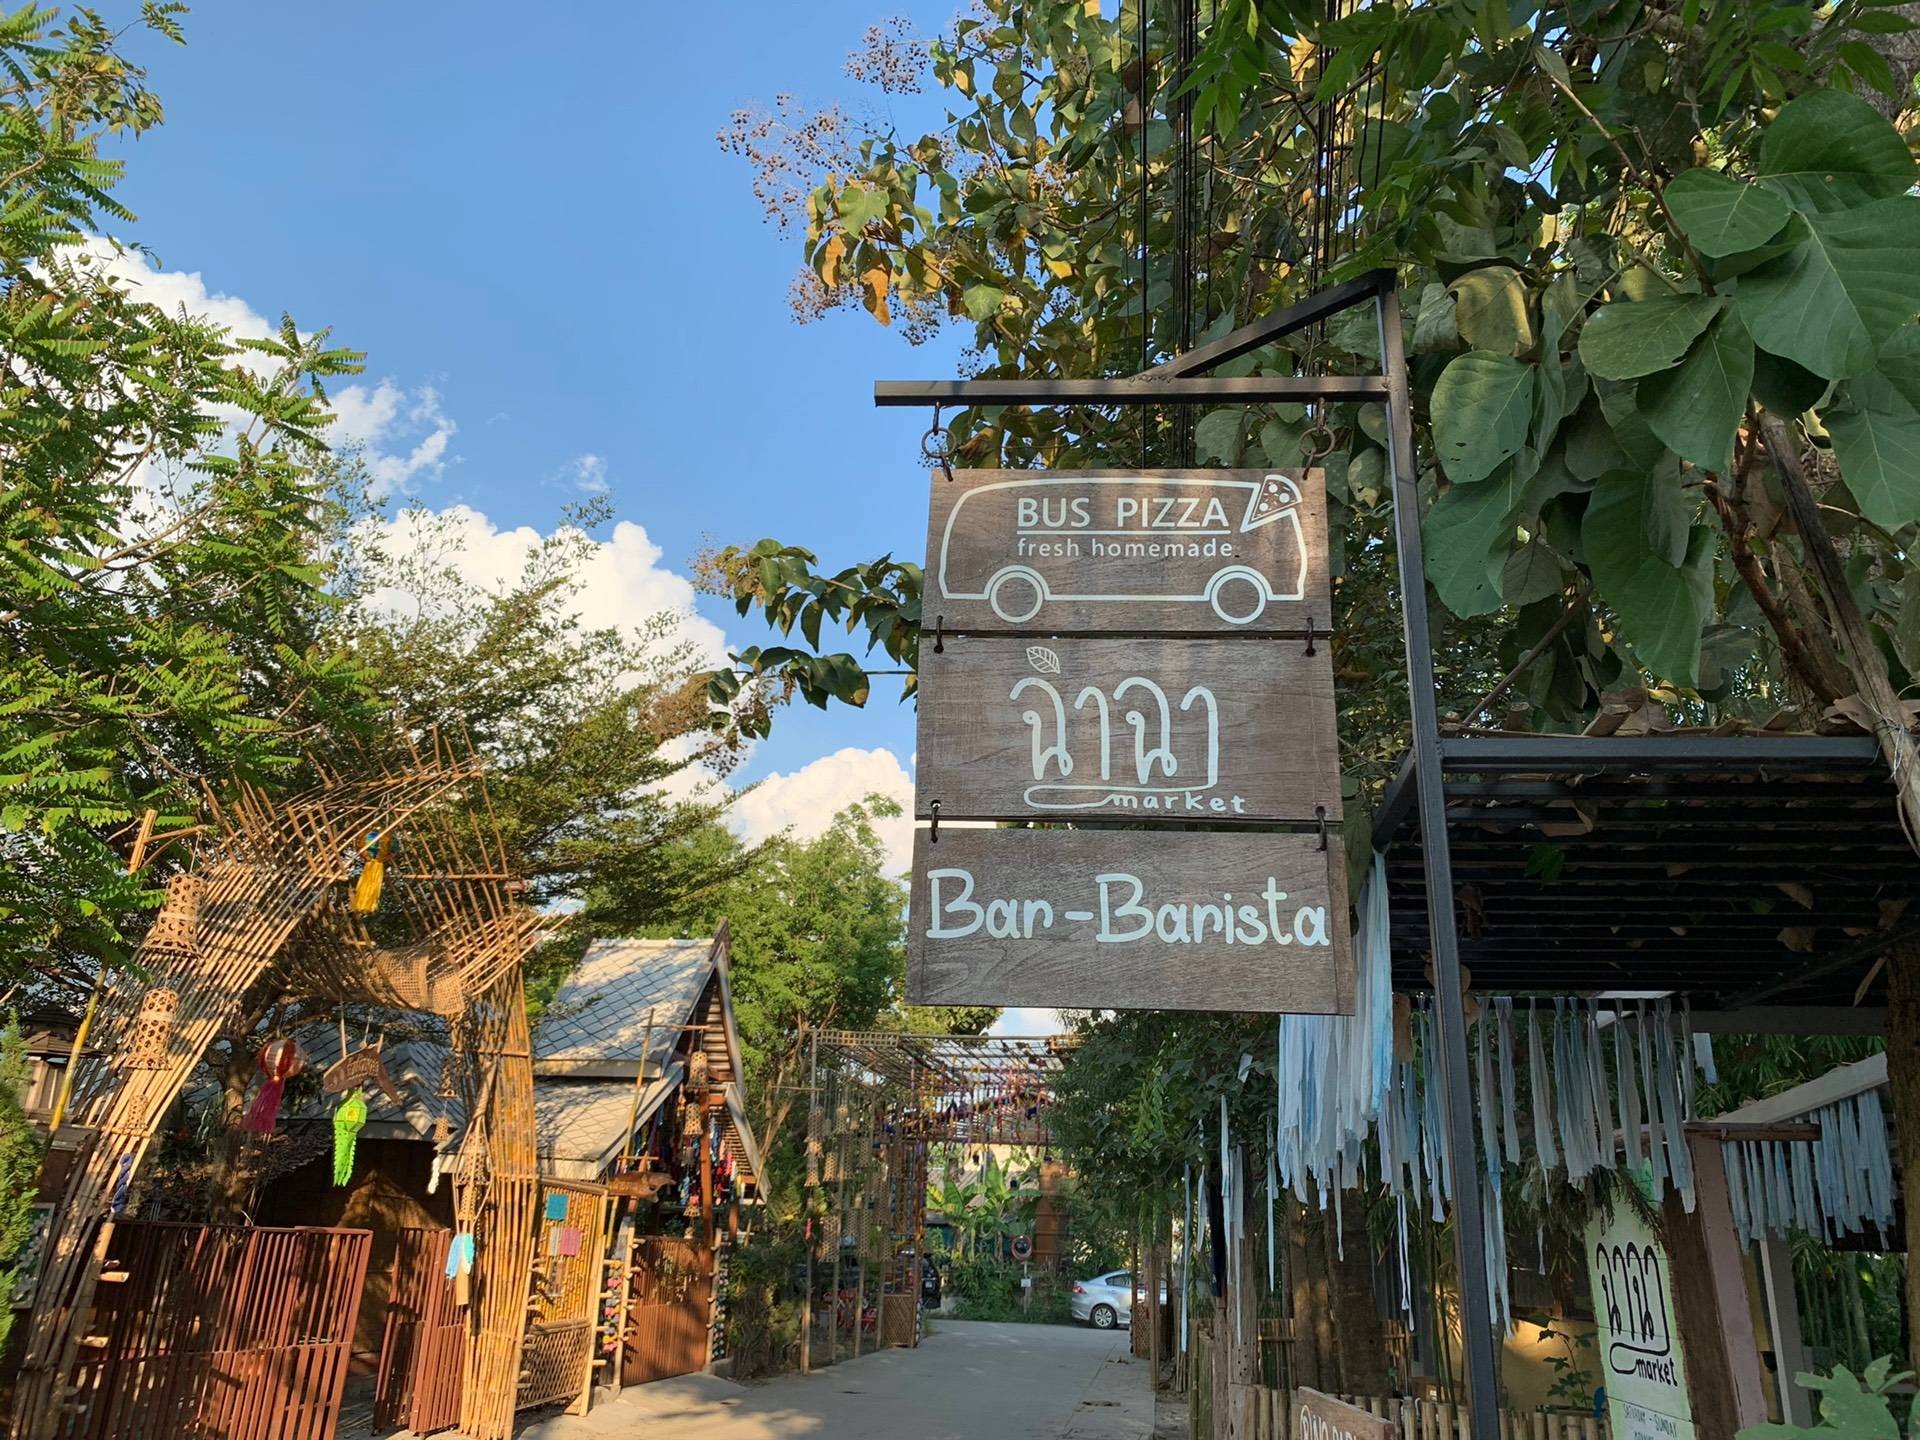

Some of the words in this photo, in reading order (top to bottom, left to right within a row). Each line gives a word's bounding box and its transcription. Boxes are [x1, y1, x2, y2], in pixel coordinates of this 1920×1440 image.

[1017, 497, 1091, 528] BUS
[1117, 498, 1231, 528] PIZZA
[1017, 538, 1080, 558] fresh
[1091, 537, 1233, 558] homemade
[1109, 791, 1246, 814] market
[1636, 1357, 1678, 1387] market
